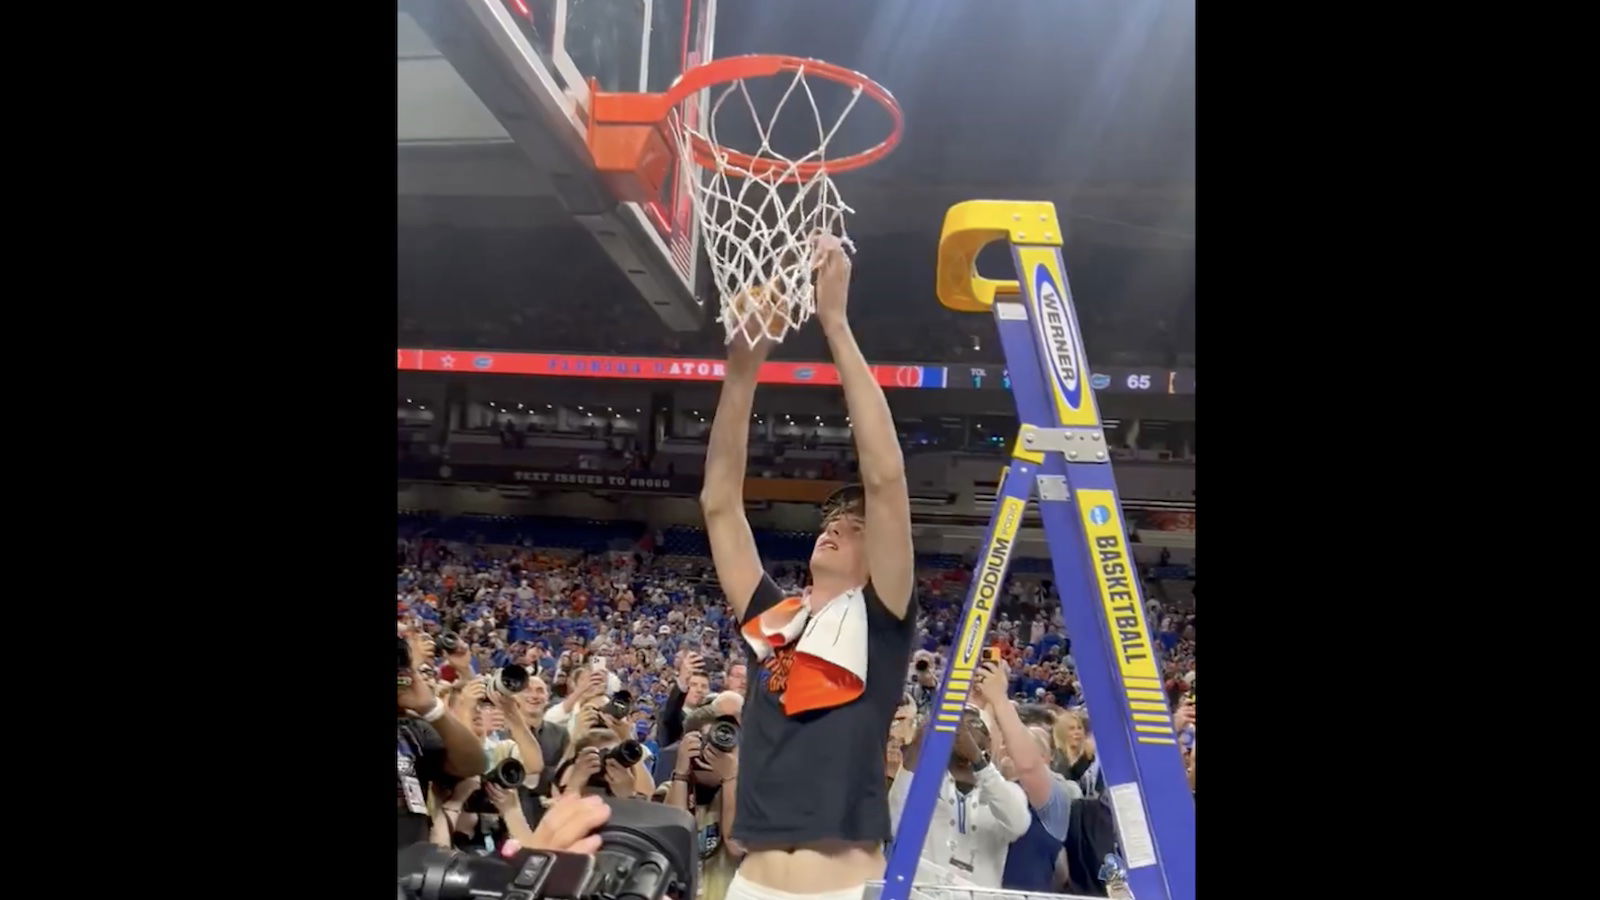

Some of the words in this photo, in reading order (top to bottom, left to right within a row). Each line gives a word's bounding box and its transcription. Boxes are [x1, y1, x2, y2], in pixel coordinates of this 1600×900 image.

[1043, 292, 1075, 381] WERNER
[1127, 374, 1151, 389] 65
[609, 475, 626, 486] TO
[976, 537, 1010, 611] PODIUM
[1095, 535, 1147, 665] BASKETBALL
